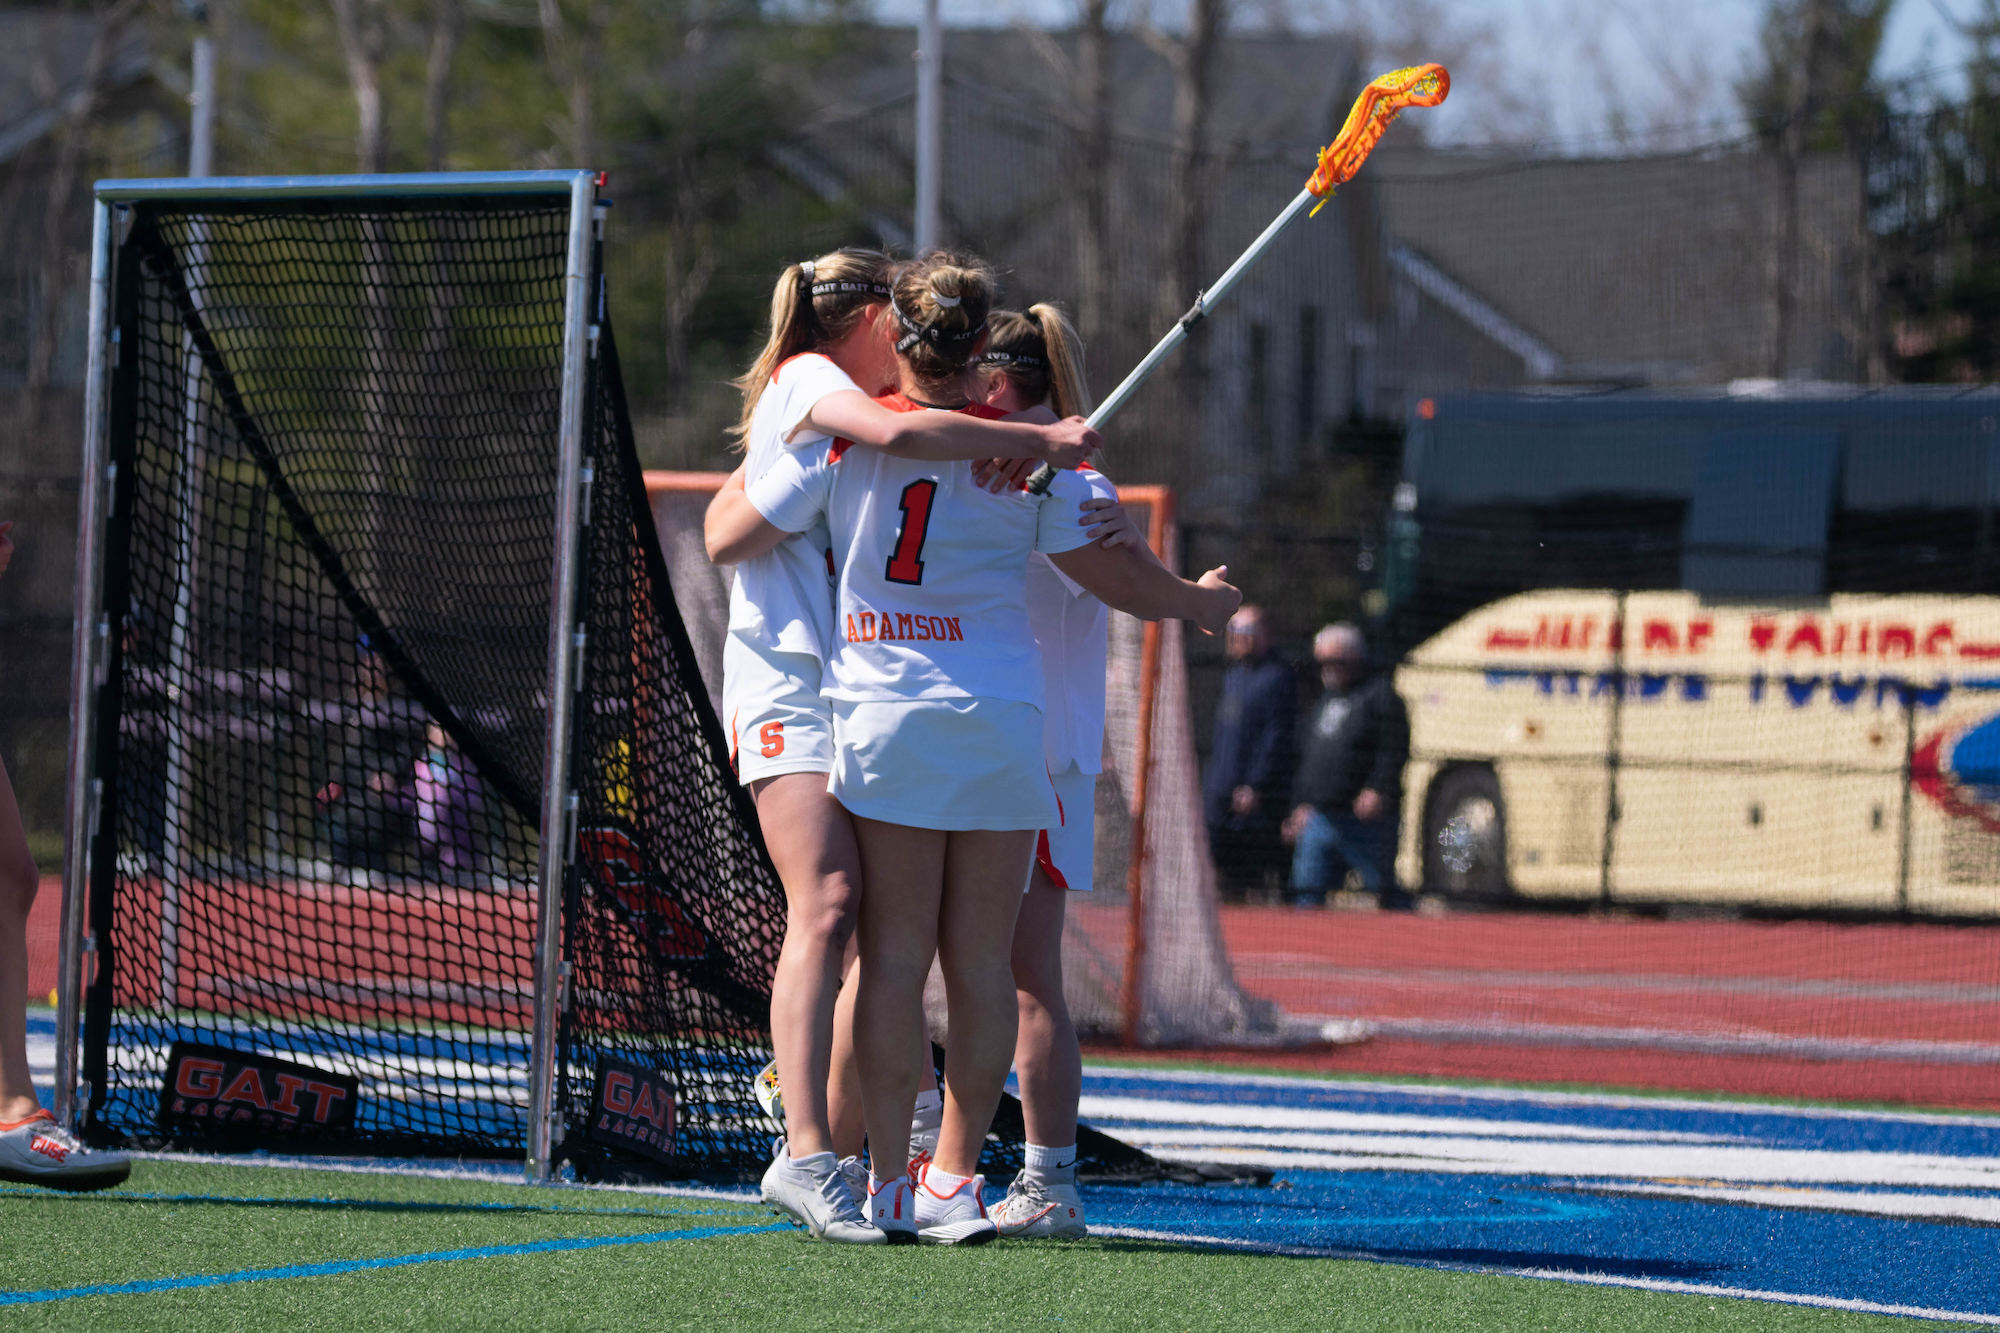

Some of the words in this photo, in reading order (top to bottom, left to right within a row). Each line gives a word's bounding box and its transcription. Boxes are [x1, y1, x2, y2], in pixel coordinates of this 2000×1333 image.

[812, 283, 836, 295] GAIT
[841, 283, 868, 292] GAIT
[885, 478, 938, 586] 1
[847, 611, 964, 643] ADAMSON
[760, 721, 785, 758] S
[173, 1056, 346, 1124] GAIT
[29, 1135, 71, 1163] CUSE
